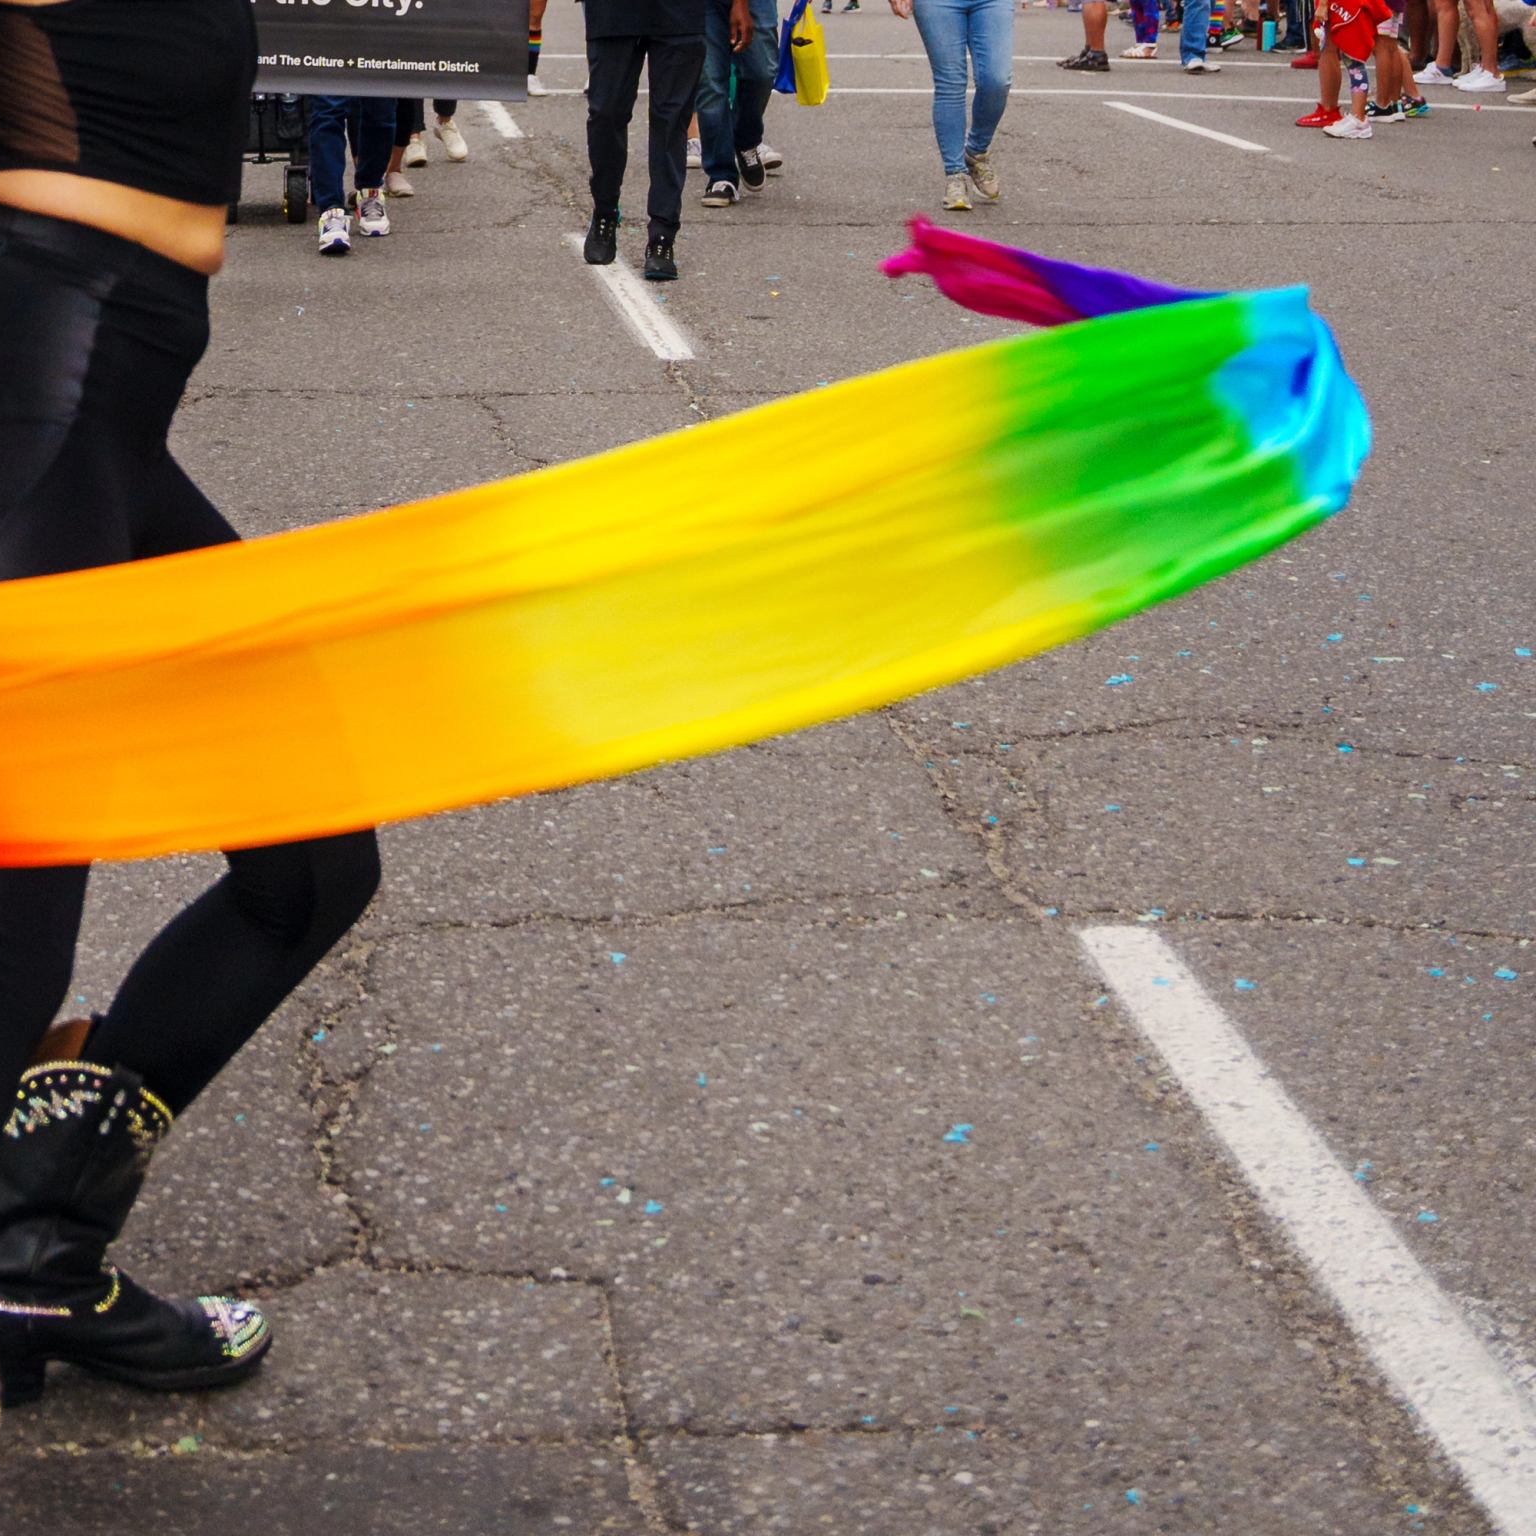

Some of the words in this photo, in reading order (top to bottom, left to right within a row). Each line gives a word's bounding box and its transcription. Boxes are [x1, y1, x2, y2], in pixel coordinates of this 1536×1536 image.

[1330, 2, 1352, 21] CAN
[257, 54, 277, 65] and
[279, 54, 301, 66] The
[303, 55, 344, 68] Culture
[357, 57, 436, 72] Entertainment
[438, 60, 480, 73] District
